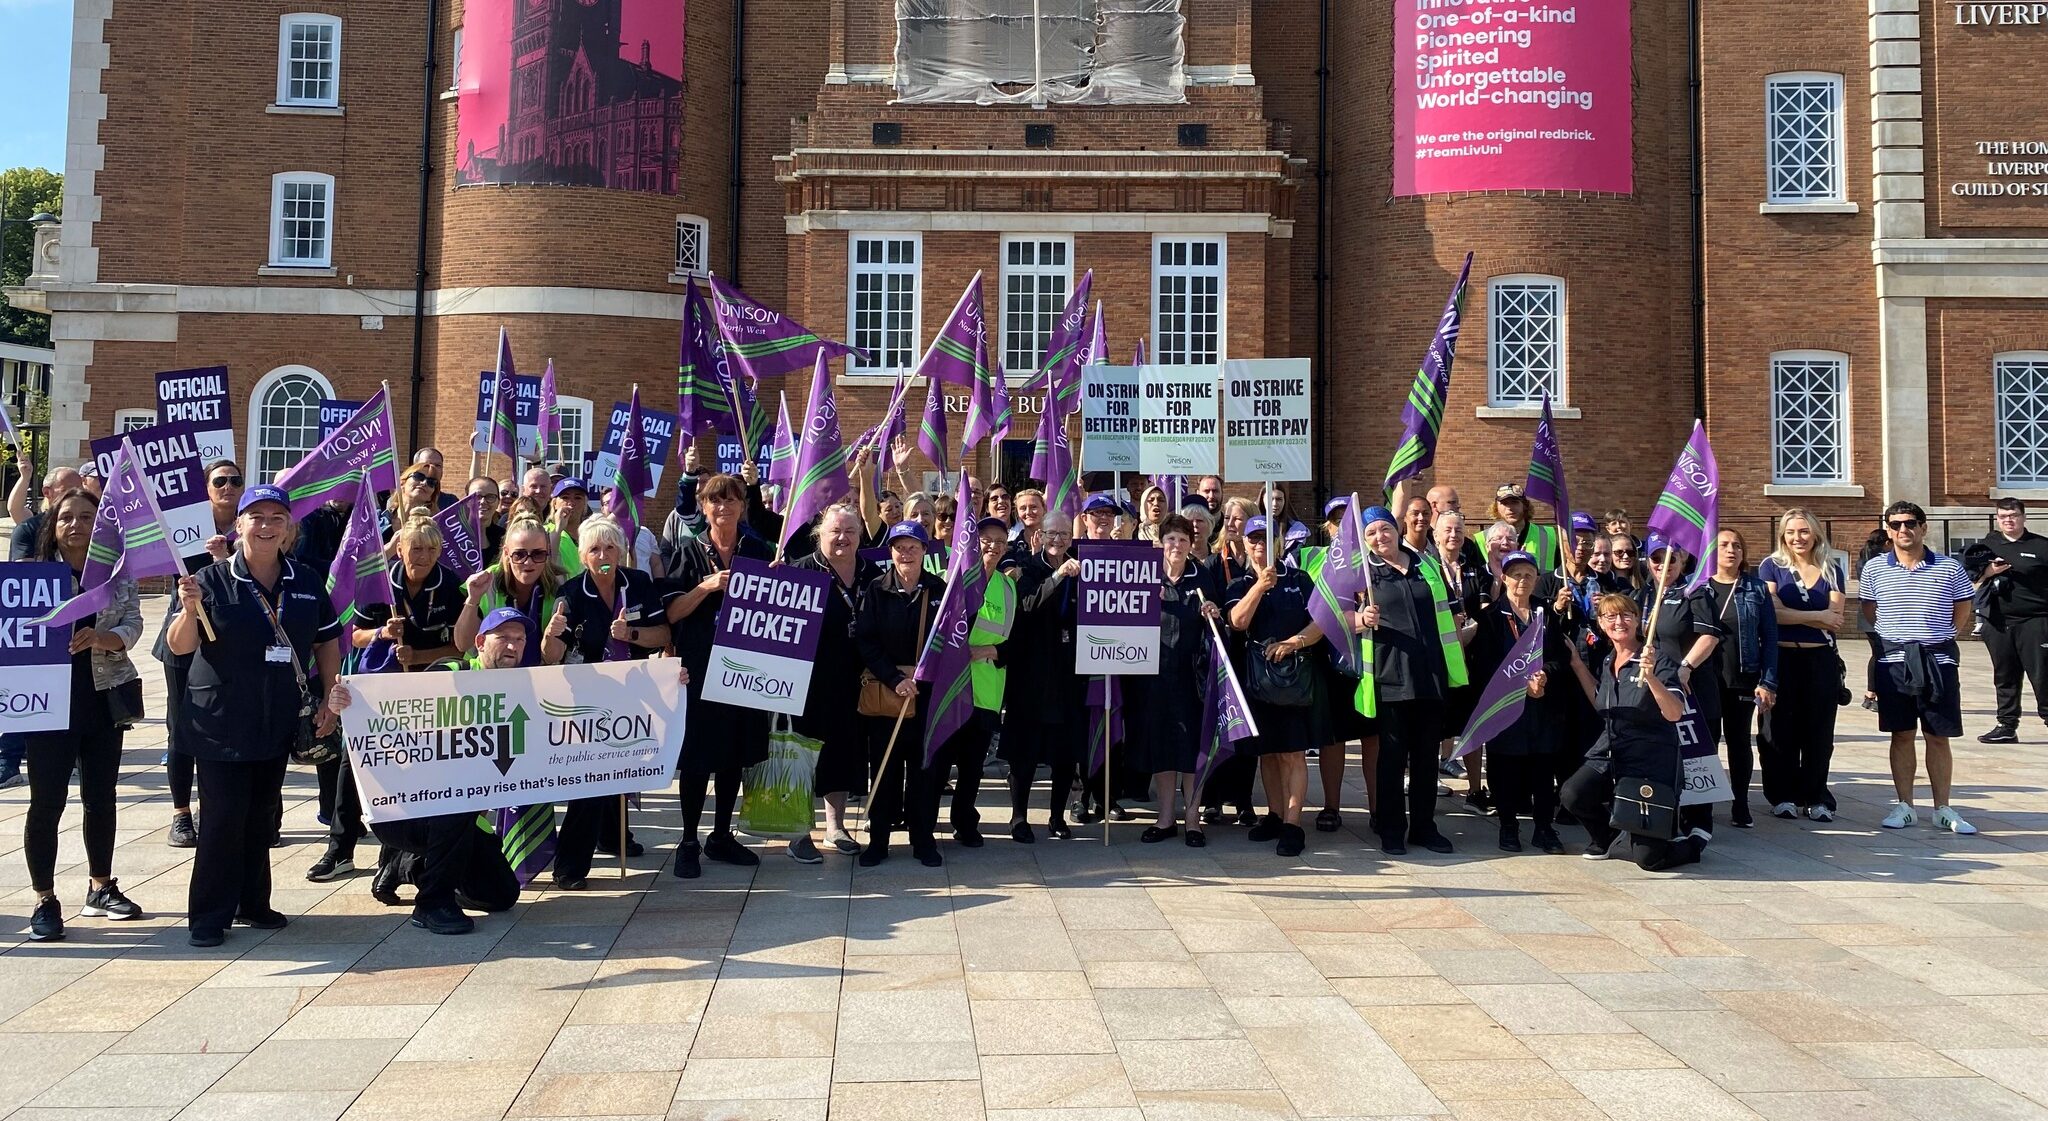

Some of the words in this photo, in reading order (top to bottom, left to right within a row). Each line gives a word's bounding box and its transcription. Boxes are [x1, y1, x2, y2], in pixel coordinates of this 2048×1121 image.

[1416, 5, 1576, 30] One-of-a-kind
[1955, 4, 2048, 25] LIVERP
[1416, 26, 1531, 50] Pioneering
[1416, 47, 1499, 73] Spirited
[1416, 67, 1566, 90] Unforgettable
[1416, 86, 1593, 109] World-changing
[1416, 135, 1436, 144] We
[1438, 134, 1460, 142] are
[1463, 130, 1484, 141] the
[1486, 129, 1537, 142] original
[1540, 129, 1596, 141] redbrick.
[1415, 143, 1503, 160] #TeamLivUni
[1976, 141, 2009, 155] THE
[1988, 162, 2048, 175] LIVERP
[1951, 182, 2004, 196] GUILD
[2007, 182, 2030, 196] OF
[720, 302, 780, 324] UNISON
[746, 325, 766, 335] West
[159, 375, 226, 401] OFFICIAL
[1088, 383, 1104, 398] ON
[1106, 383, 1139, 399] STRIK
[1146, 383, 1163, 398] ON
[1166, 383, 1212, 398] STRIKE
[1231, 380, 1251, 397] ON
[1254, 379, 1304, 397] STRIKE
[166, 399, 221, 424] PICKET
[321, 407, 359, 424] OFFI
[1106, 401, 1129, 415] FOR
[1166, 401, 1191, 416] FOR
[1253, 399, 1281, 416] FOR
[611, 409, 672, 438] OFCIAL
[1085, 418, 1128, 432] BETTER
[1142, 419, 1189, 434] BETTER
[1192, 419, 1216, 434] PAY
[1227, 420, 1279, 437] BETTER
[1281, 419, 1309, 436] PAY
[1255, 462, 1282, 470] UNISON
[1678, 453, 1717, 497] NISON
[148, 468, 189, 500] KET
[445, 514, 482, 573] UNISON
[1080, 558, 1161, 584] OFFICIAL
[2, 578, 61, 608] CIAL
[728, 571, 824, 614] OFFICIAL
[1086, 589, 1151, 614] PICKET
[726, 606, 808, 645] PICKET
[1090, 645, 1148, 661] UNISON
[722, 669, 794, 697] UNISON
[379, 698, 434, 716] WE'RE
[436, 693, 506, 728] MORE
[367, 714, 434, 733] WORTH
[548, 714, 652, 747] UNISON
[347, 734, 377, 751] WE
[380, 730, 434, 749] CAN'T
[436, 725, 495, 760] LESS
[360, 747, 434, 768] AFFORD
[549, 753, 564, 765] the
[566, 749, 595, 766] public
[597, 747, 630, 760] service
[632, 746, 659, 757] union
[372, 792, 406, 806] can't
[409, 787, 452, 801] afford
[455, 788, 464, 797] a
[467, 785, 491, 799] pay
[494, 781, 517, 793] rise
[520, 776, 554, 790] that's
[557, 774, 581, 786] less
[584, 770, 610, 783] than
[613, 765, 665, 780] inflation!
